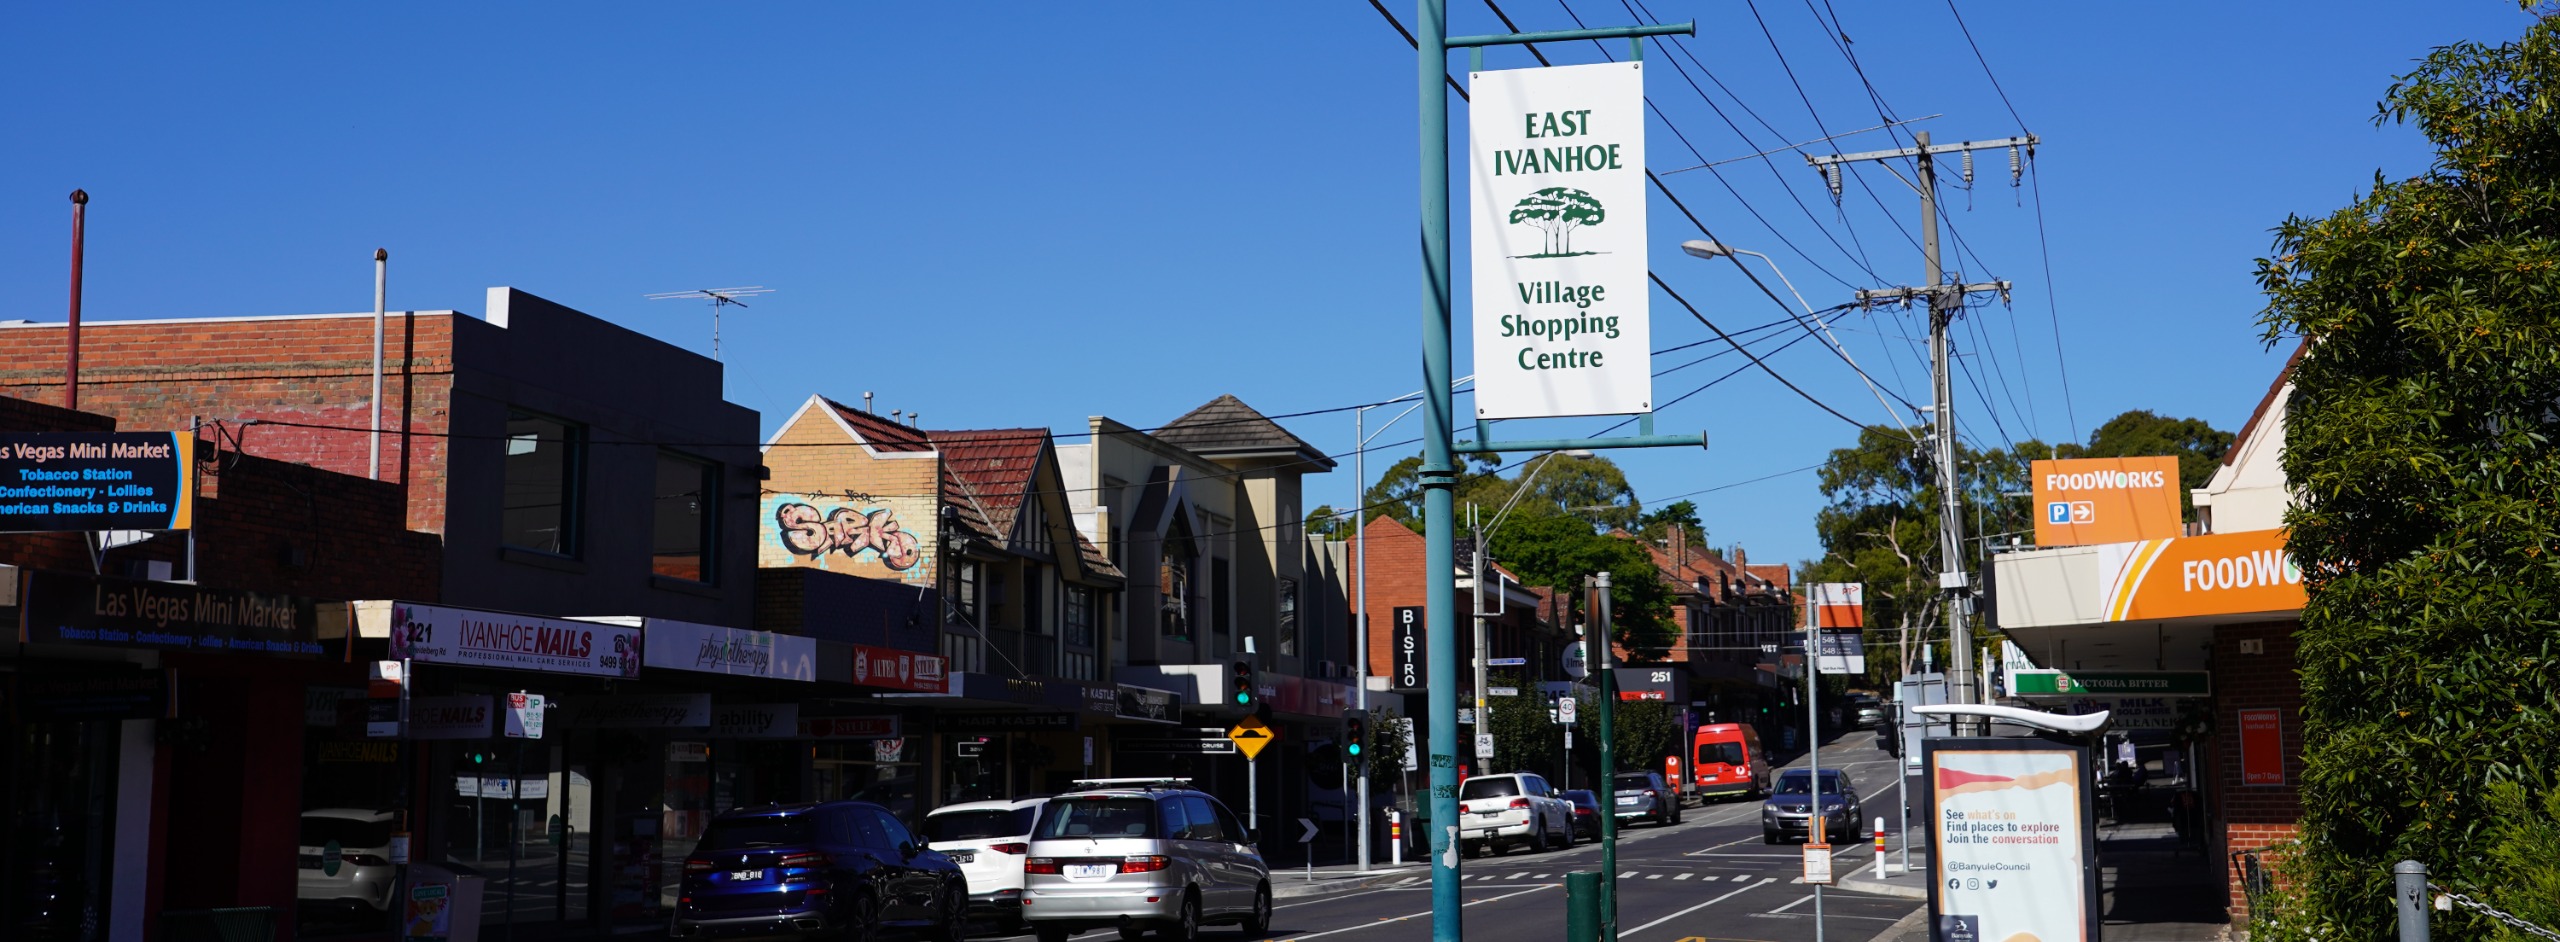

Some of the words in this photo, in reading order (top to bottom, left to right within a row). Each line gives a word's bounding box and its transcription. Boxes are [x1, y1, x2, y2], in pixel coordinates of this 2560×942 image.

[1525, 109, 1591, 139] EAST
[1494, 143, 1622, 176] IVANHOE
[1518, 280, 1605, 309] Village
[1501, 311, 1620, 342] Shopping
[1518, 347, 1604, 371] Centre
[14, 442, 65, 463] Vegas
[70, 442, 107, 459] Mini
[111, 441, 170, 459] Market
[19, 468, 80, 481] Tobacco
[83, 468, 133, 481] Station
[2046, 469, 2165, 491] FOODWORKS
[0, 485, 96, 499] Confectionery
[108, 484, 154, 498] Lollies
[53, 501, 104, 515] Snacks
[108, 502, 120, 514] &
[122, 500, 168, 514] Drinks
[2183, 548, 2302, 592] FOODWO
[95, 584, 127, 617] Las
[132, 586, 189, 628] Vegas
[194, 591, 233, 626] Mini
[238, 597, 297, 630] Market
[59, 625, 97, 640] Tobacco
[99, 627, 130, 642] Station
[136, 630, 192, 648] Confectionery
[198, 634, 223, 649] Lollies
[229, 636, 265, 651] American
[406, 621, 432, 643] 221
[534, 626, 592, 658] NAILS
[1822, 636, 1836, 644] 546
[413, 646, 438, 657] eidelberg
[1402, 609, 1416, 687] BISTRO
[1760, 644, 1777, 653] VET
[1822, 647, 1836, 655] 548
[458, 650, 514, 662] PROFESSIONAL
[518, 655, 533, 664] NAIL
[537, 657, 554, 666] CARE
[558, 659, 591, 668] SERVICES
[600, 655, 616, 669] 9499
[1651, 671, 1671, 683] 251
[2072, 678, 2127, 688] VICTORIA
[2128, 679, 2169, 688] BITTER
[511, 694, 524, 702] BUS
[1090, 687, 1114, 700] KASTLE
[1562, 703, 1572, 711] 40
[2121, 698, 2163, 708] MILK
[440, 706, 485, 724] NAILS
[2117, 708, 2142, 716] SOLD
[2145, 707, 2170, 715] HERE
[720, 710, 774, 728] ability
[959, 716, 995, 726] HAIR
[1001, 715, 1068, 726] KASTLE
[2116, 718, 2176, 728] CLEANER
[2247, 772, 2261, 781] Open
[2267, 772, 2280, 781] Days
[1946, 809, 1964, 820] See
[1967, 809, 2000, 820] what's
[2003, 812, 2016, 820] on
[1946, 821, 1968, 832] Find
[1971, 821, 2004, 835] places
[2008, 823, 2018, 832] to
[2021, 821, 2060, 835] explore
[1946, 833, 1969, 844] Join
[1973, 833, 1989, 844] the
[1992, 833, 2059, 845] conversation
[1947, 861, 2030, 873] @BanyuleCouncil
[1951, 932, 1973, 940] Banyule
